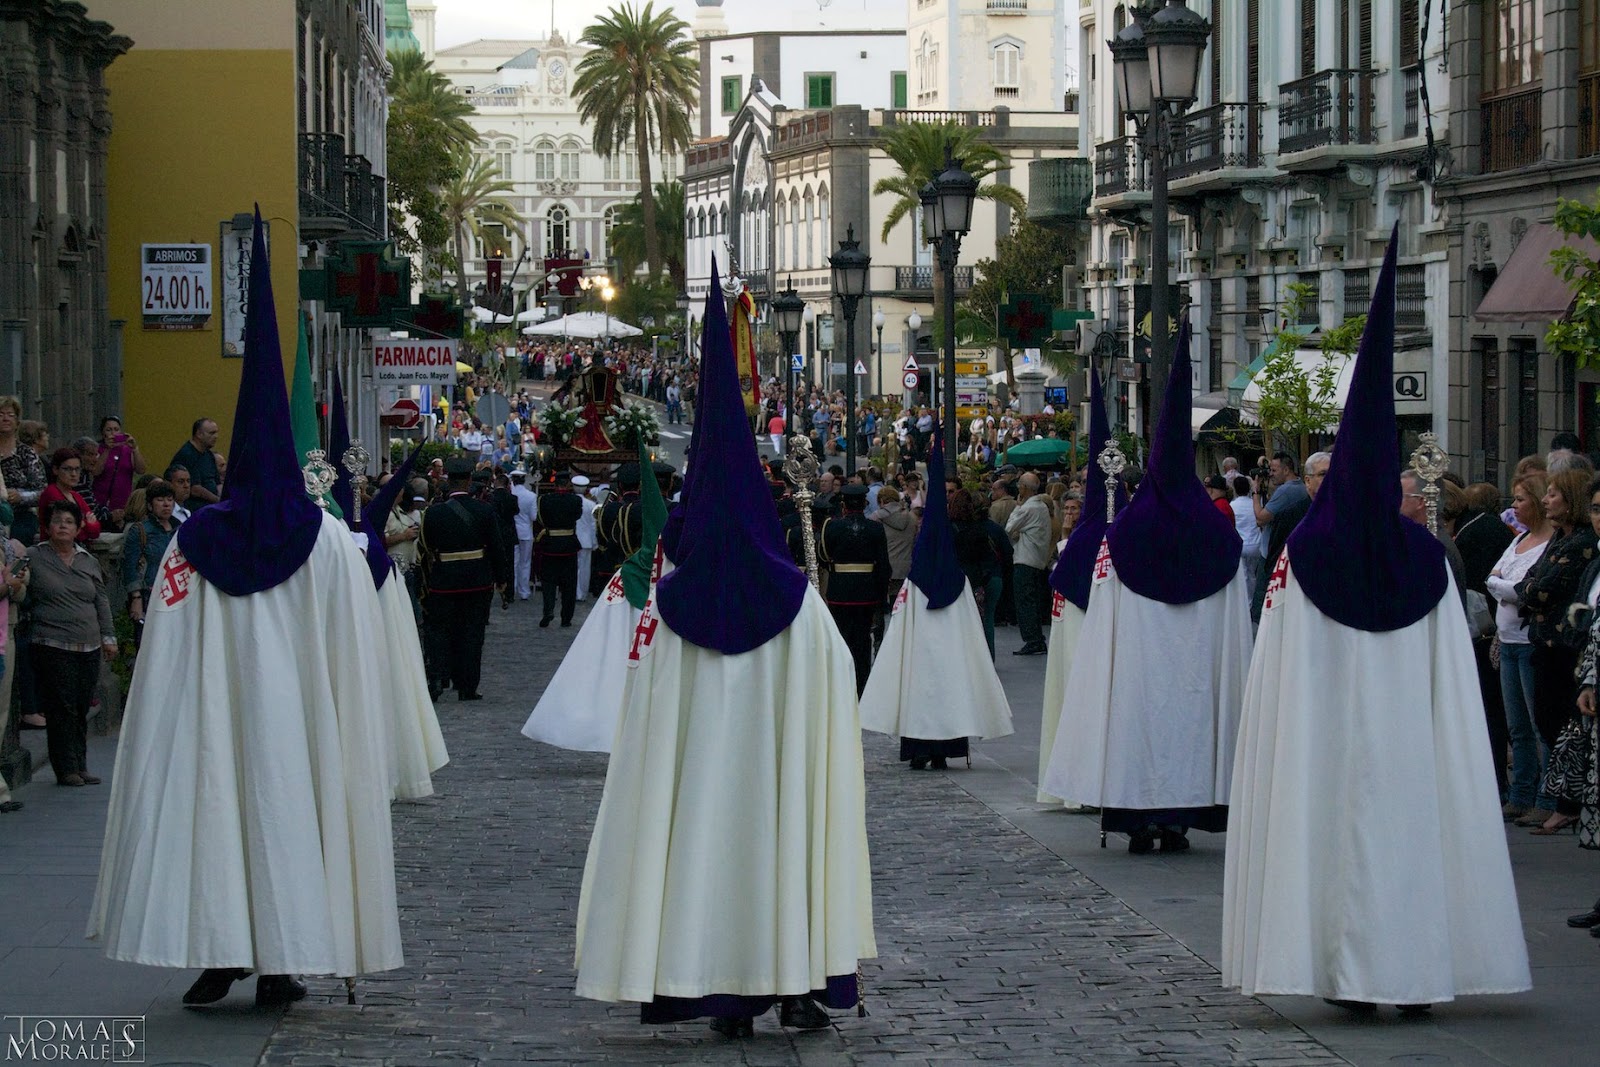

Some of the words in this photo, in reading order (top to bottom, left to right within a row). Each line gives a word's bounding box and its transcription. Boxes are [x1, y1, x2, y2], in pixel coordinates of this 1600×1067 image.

[155, 250, 197, 262] ABRIMOS
[144, 275, 189, 309] 24.00
[195, 275, 209, 309] h.
[375, 346, 452, 366] FARMACIA
[379, 372, 396, 380] Lcdo.
[398, 372, 413, 380] Juan
[415, 372, 428, 380] Fco.
[430, 372, 449, 381] Mayor
[1395, 375, 1423, 397] Q
